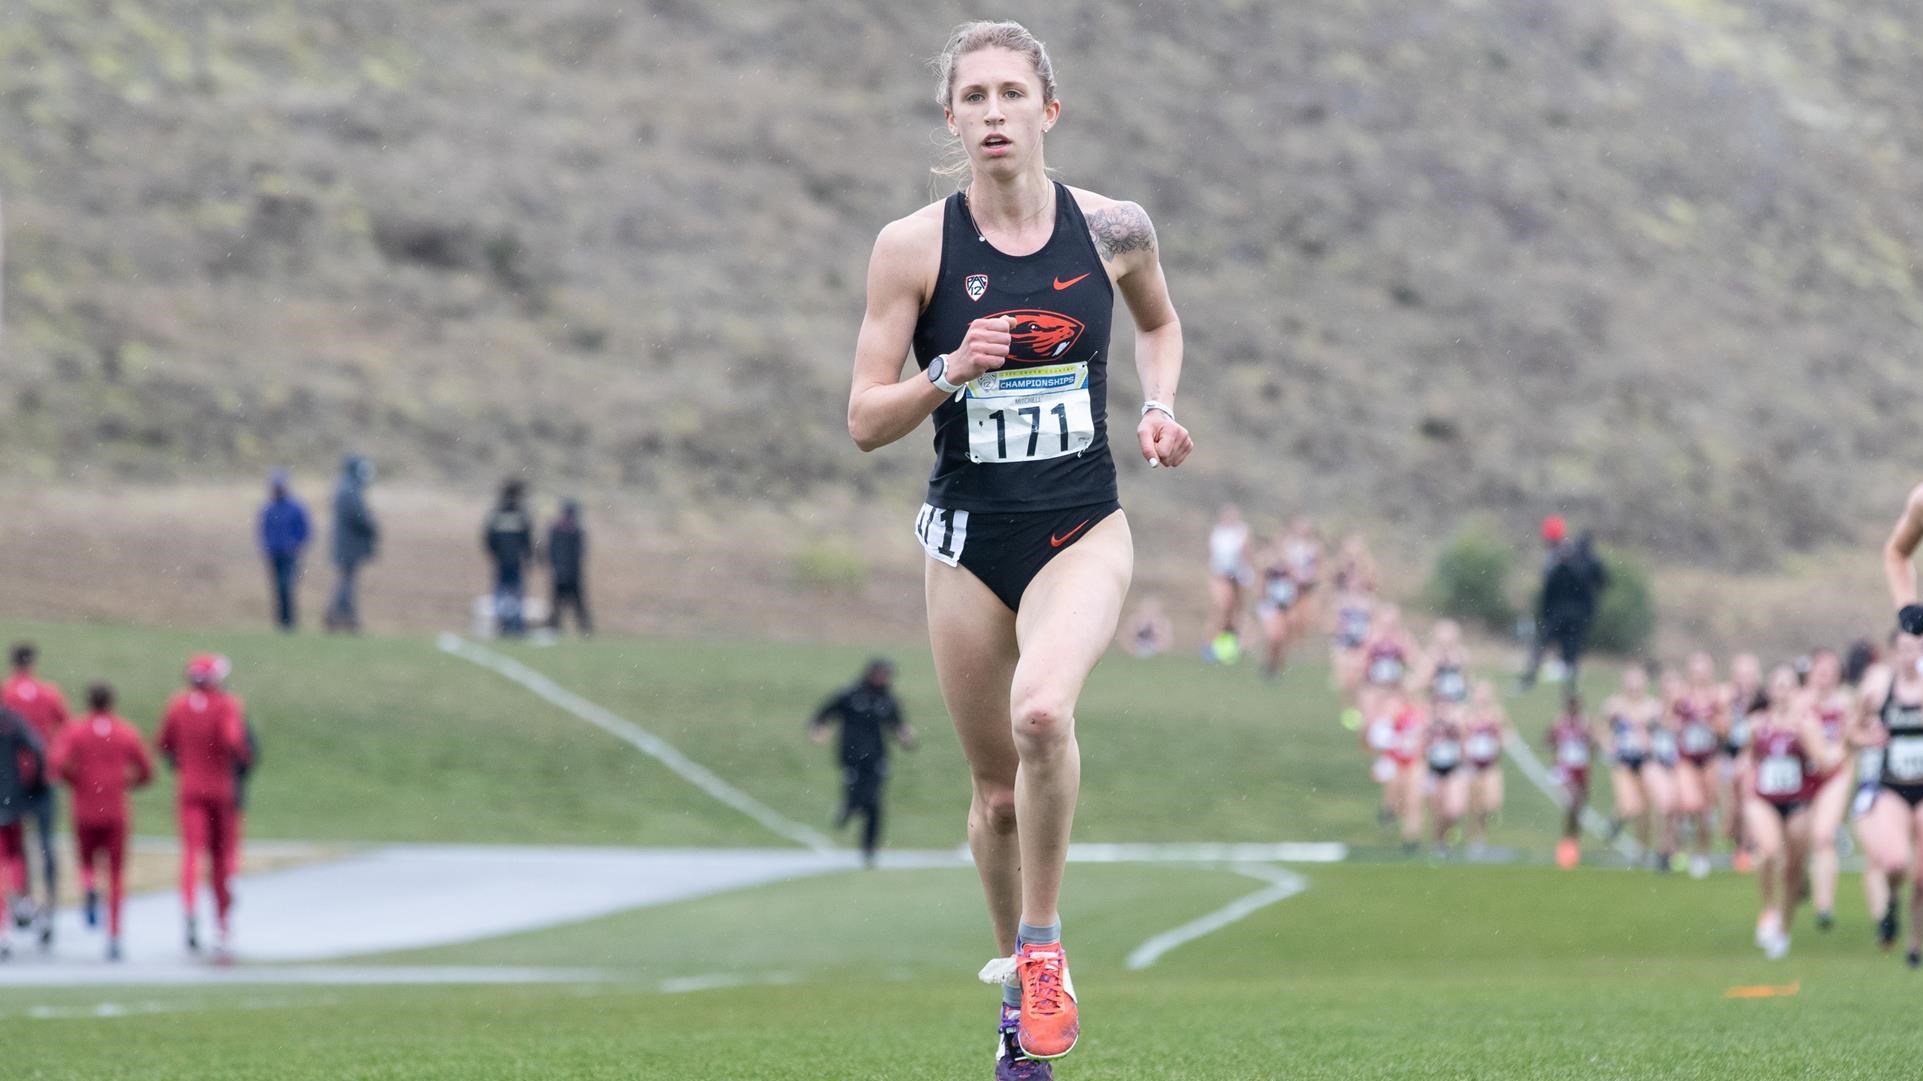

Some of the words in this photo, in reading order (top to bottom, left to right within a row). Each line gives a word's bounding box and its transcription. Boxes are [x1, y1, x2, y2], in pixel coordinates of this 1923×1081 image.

[967, 275, 987, 290] PAC
[970, 286, 981, 296] 12
[1000, 375, 1075, 389] CHAMPIONSHIPS
[989, 403, 1068, 459] 171
